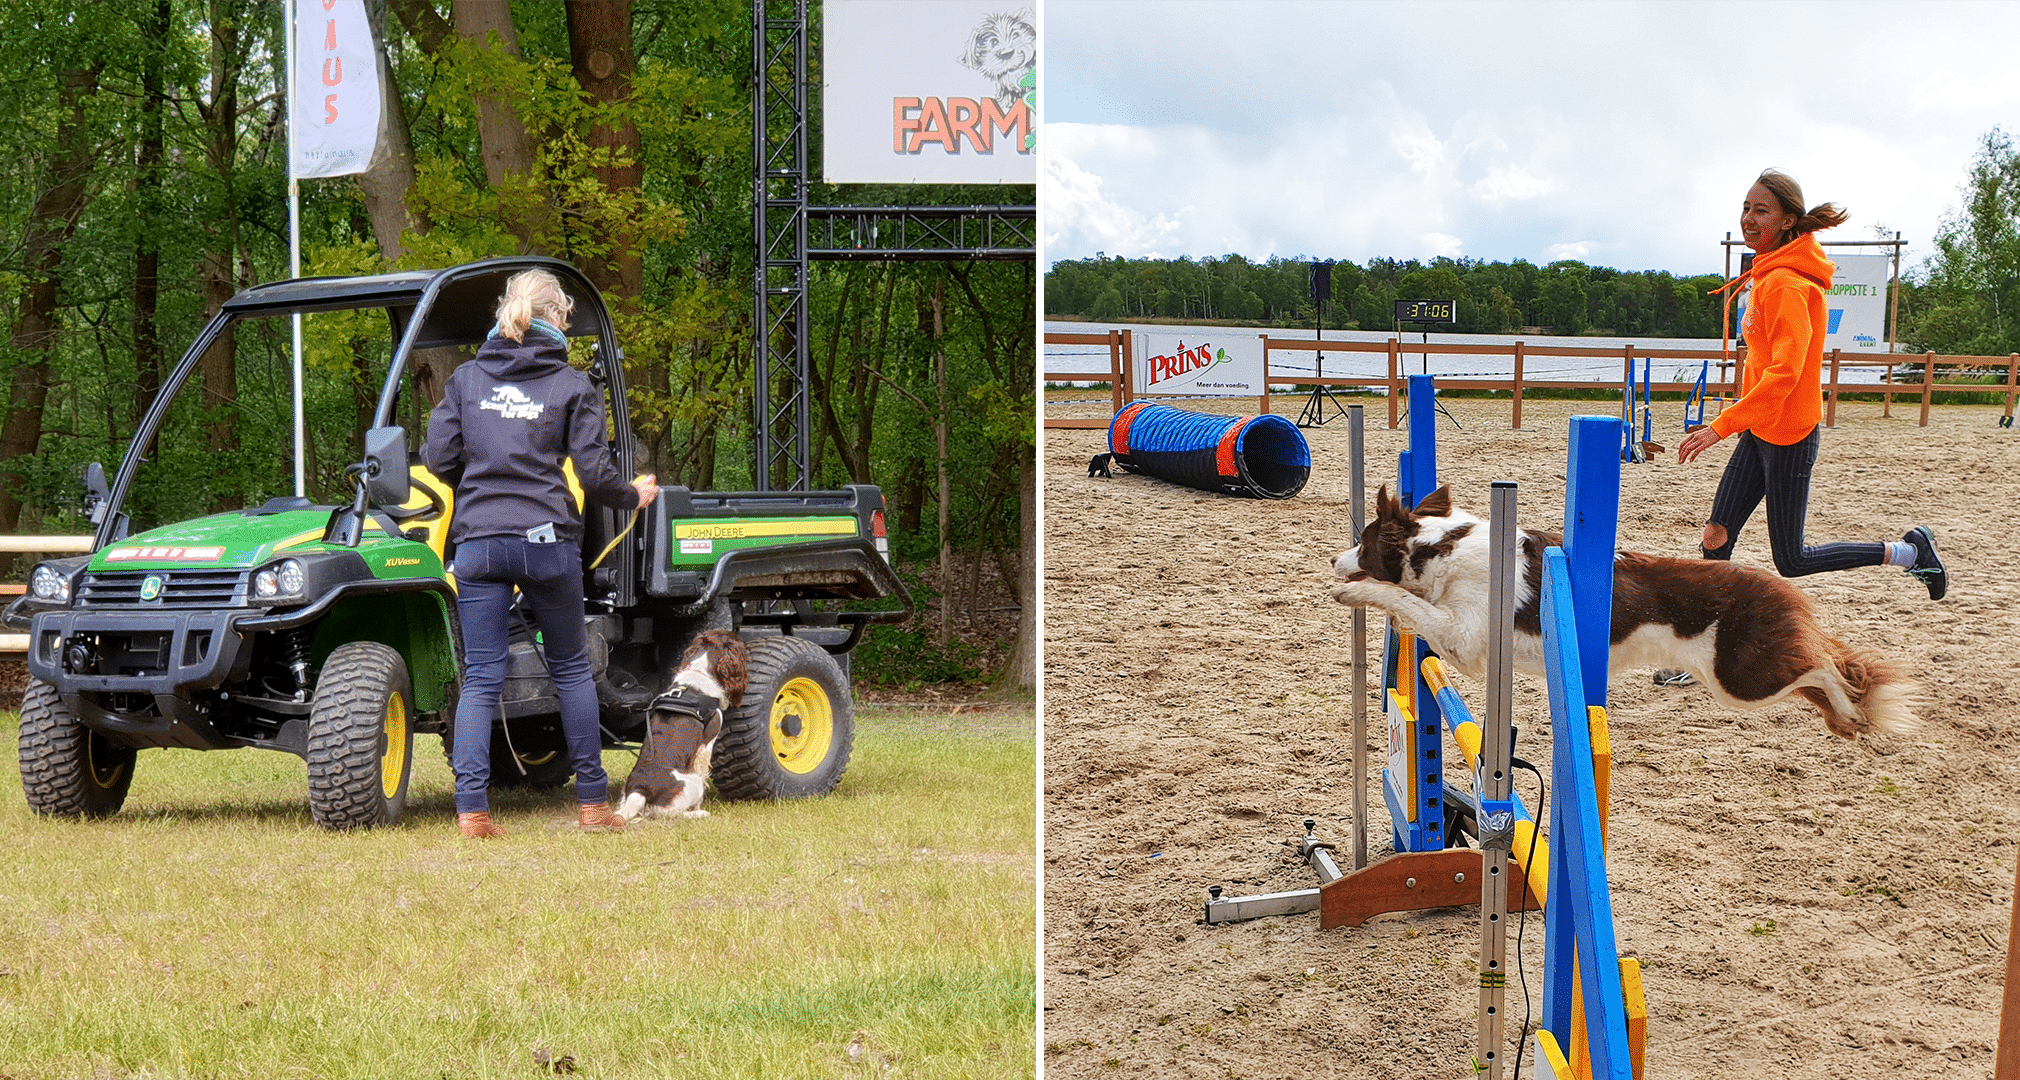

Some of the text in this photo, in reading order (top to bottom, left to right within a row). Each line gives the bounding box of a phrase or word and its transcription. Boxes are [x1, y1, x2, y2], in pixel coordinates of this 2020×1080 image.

[893, 97, 1031, 155] FARM
[1871, 286, 1877, 296] 1
[687, 526, 744, 538] JOHN DEERE
